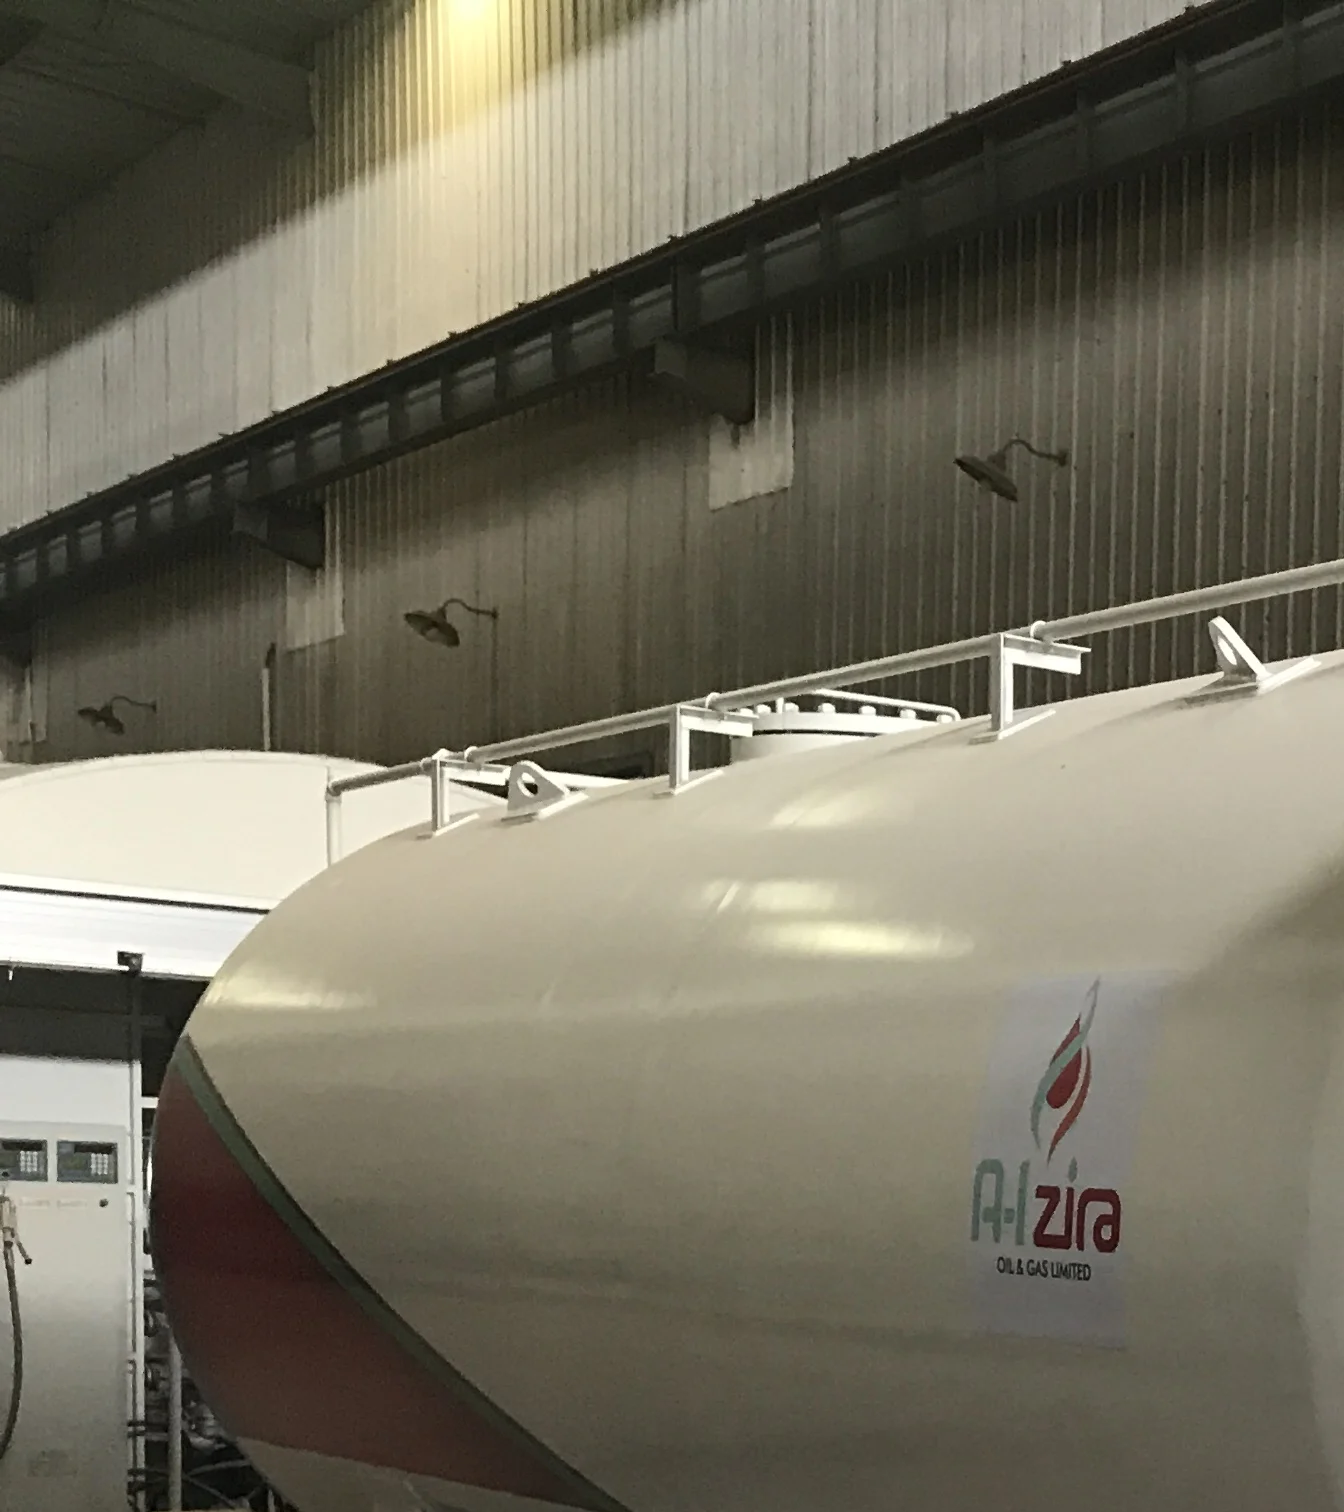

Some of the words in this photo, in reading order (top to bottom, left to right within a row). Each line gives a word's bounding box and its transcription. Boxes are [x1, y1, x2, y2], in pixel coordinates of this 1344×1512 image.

[996, 1256, 1014, 1275] OIL
[1016, 1258, 1025, 1275] &
[1026, 1259, 1049, 1278] GAS
[1050, 1261, 1092, 1281] LIMITED
